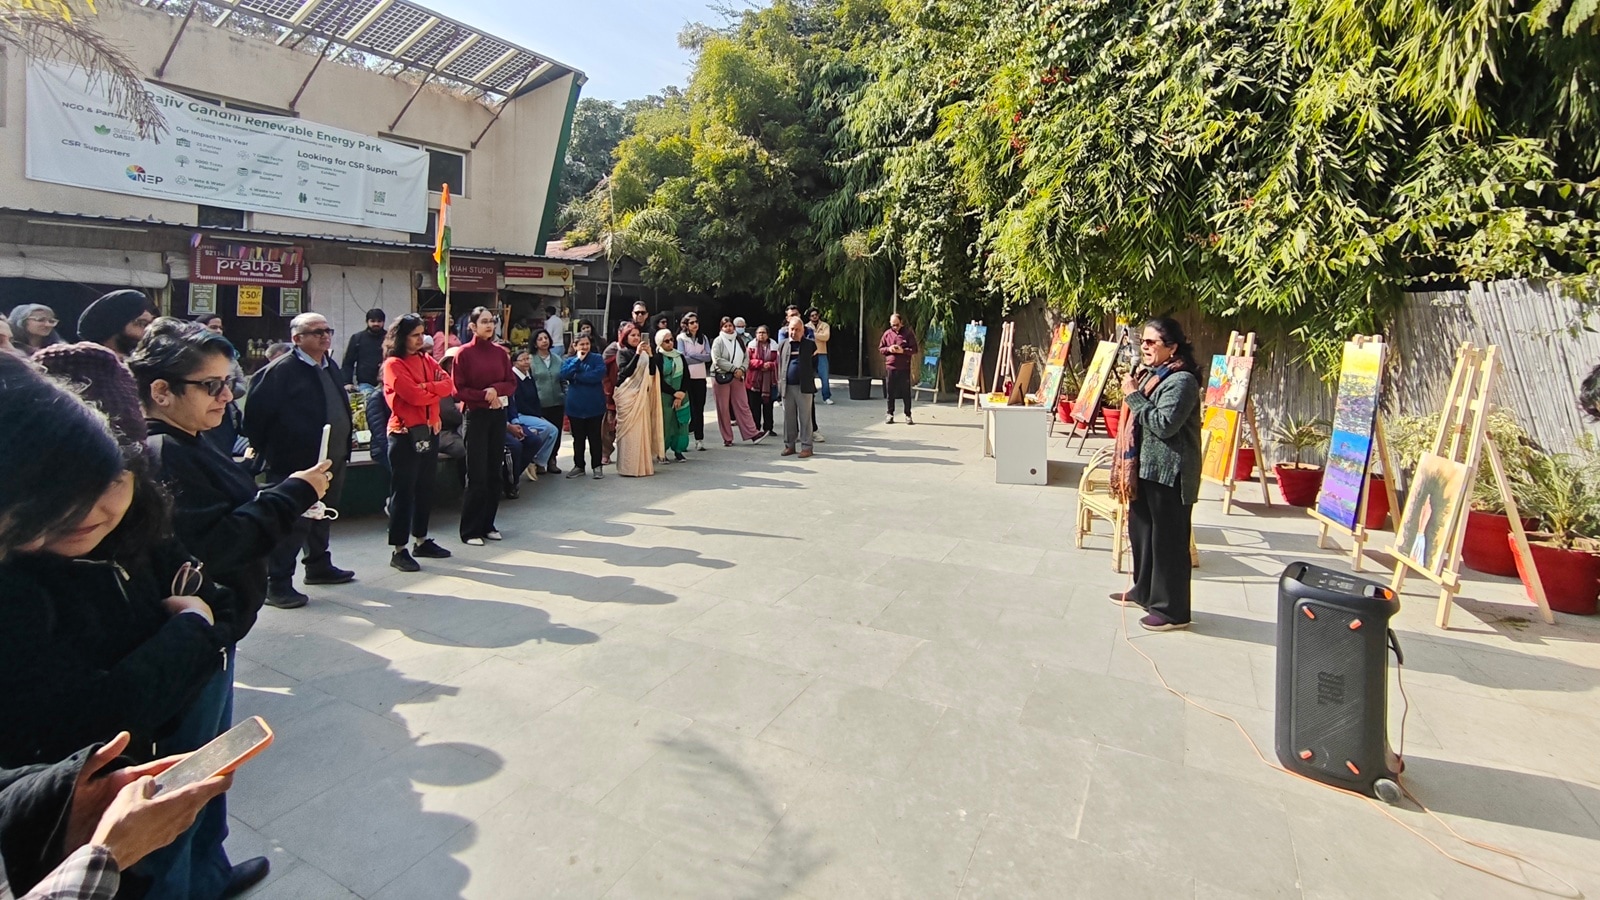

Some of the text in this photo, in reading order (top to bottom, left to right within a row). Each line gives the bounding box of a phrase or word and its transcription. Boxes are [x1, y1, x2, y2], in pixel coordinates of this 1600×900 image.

[62, 102, 84, 111] NGO
[144, 91, 383, 154] Rajiv Gandhi Renewable Energy Park
[113, 133, 136, 142] OASIS
[191, 129, 216, 140] Impact
[218, 135, 232, 143] This
[62, 139, 130, 158] CSR Supporters
[203, 143, 222, 151] Partner
[298, 150, 398, 176] Looking for CSR Support
[217, 256, 282, 274] pratha
[469, 266, 494, 274] STUDIO
[1317, 671, 1345, 706] JBL
